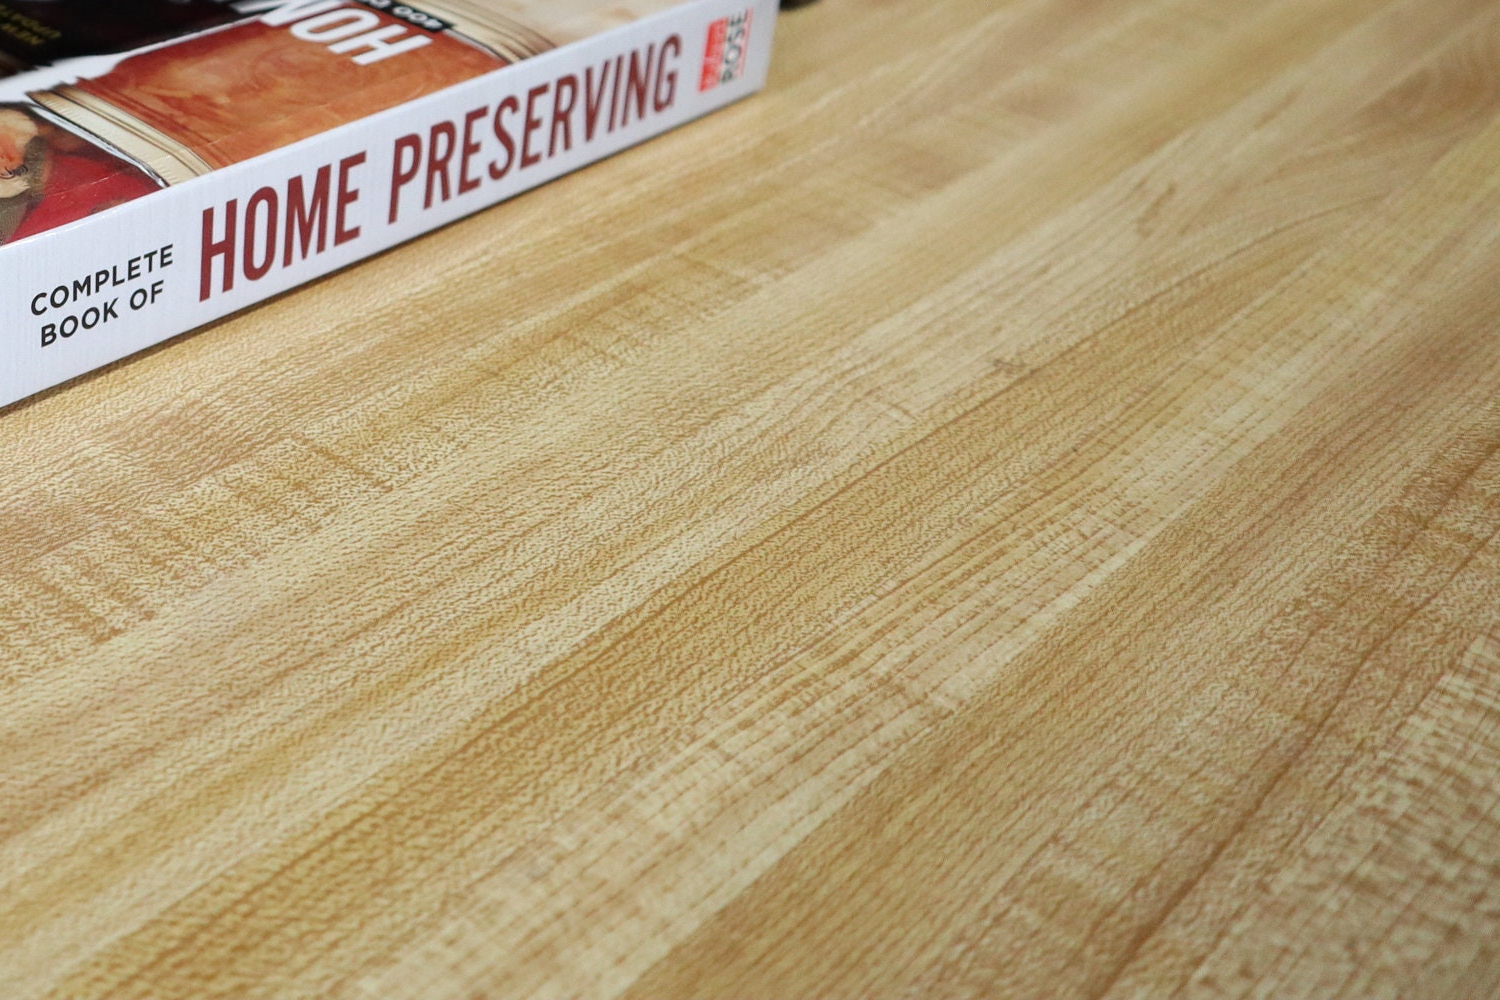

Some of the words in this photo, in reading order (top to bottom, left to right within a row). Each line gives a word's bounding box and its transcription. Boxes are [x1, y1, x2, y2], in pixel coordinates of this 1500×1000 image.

[199, 150, 367, 303] HOME
[388, 33, 683, 225] PRESERVING
[29, 244, 174, 316] COMPLETE
[40, 296, 119, 348] BOOK
[129, 280, 165, 312] OF
